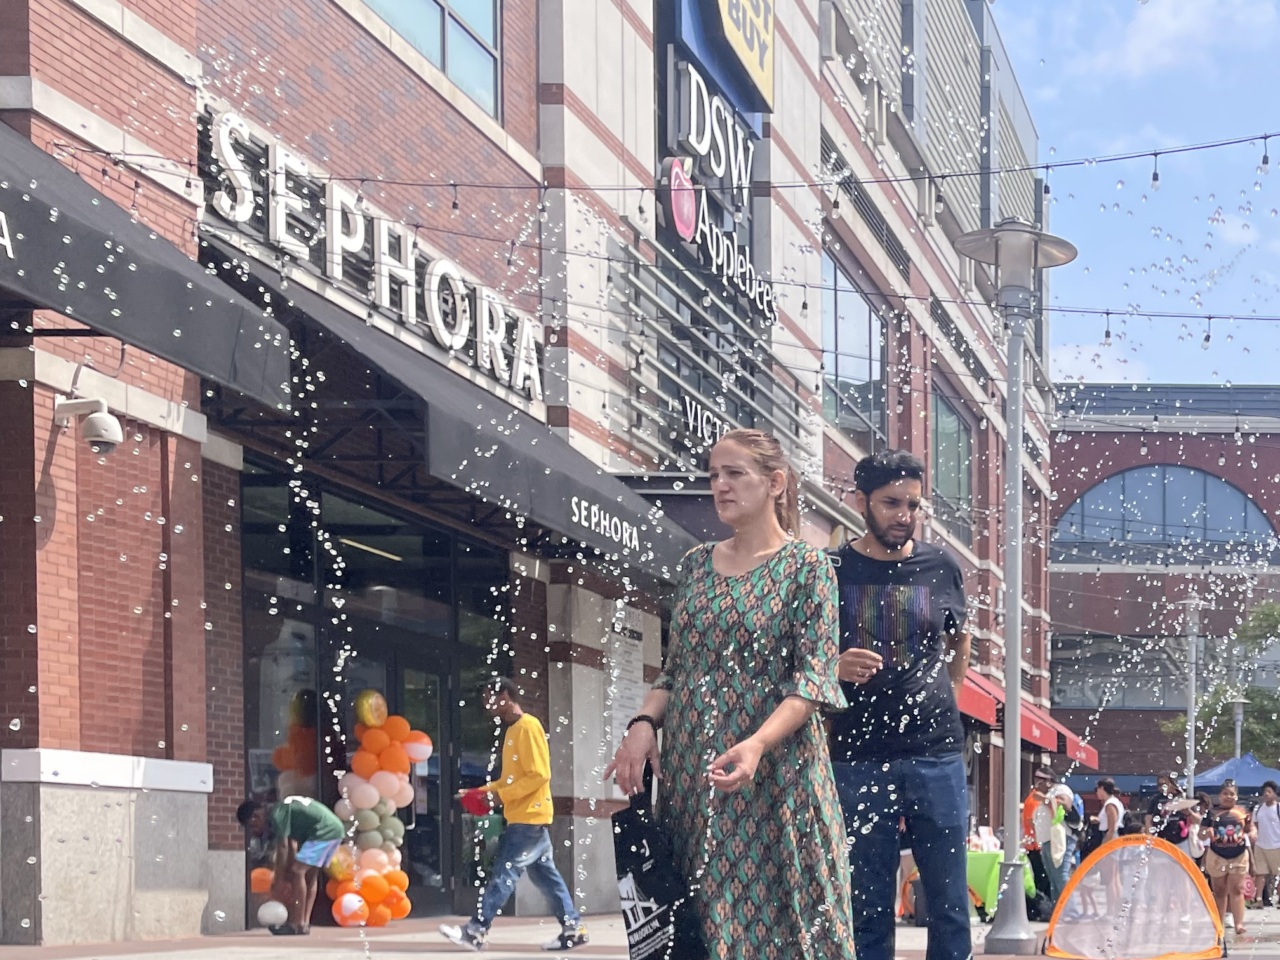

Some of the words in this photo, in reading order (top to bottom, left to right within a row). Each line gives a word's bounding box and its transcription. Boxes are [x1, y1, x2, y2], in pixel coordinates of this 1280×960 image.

[728, 0, 768, 72] BUY
[687, 62, 754, 207] DSW
[211, 112, 543, 401] SEPHORA
[685, 395, 731, 444] VICT
[572, 496, 639, 551] SEPHORA
